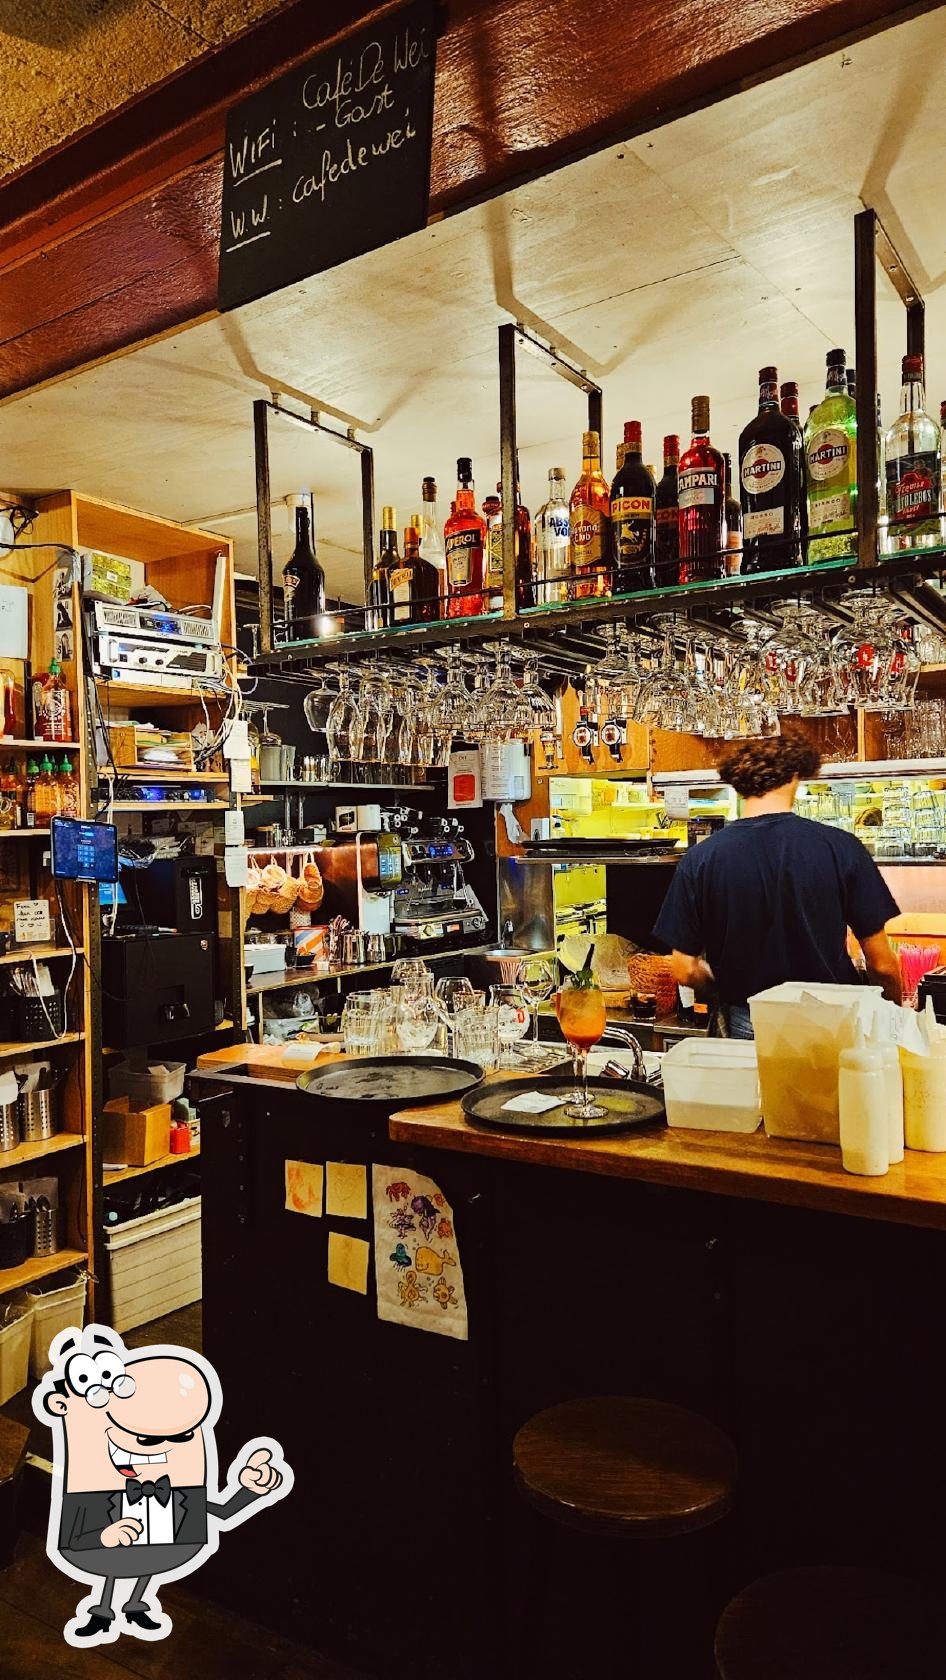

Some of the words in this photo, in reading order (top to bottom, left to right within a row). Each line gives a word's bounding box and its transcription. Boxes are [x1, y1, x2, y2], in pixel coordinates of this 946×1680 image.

[810, 446, 847, 463] MARTINI
[744, 461, 781, 478] MARTINI
[612, 499, 650, 514] PICON
[656, 506, 678, 520] CON
[549, 517, 569, 528] ABS
[573, 523, 598, 537] avana
[573, 531, 591, 543] Club
